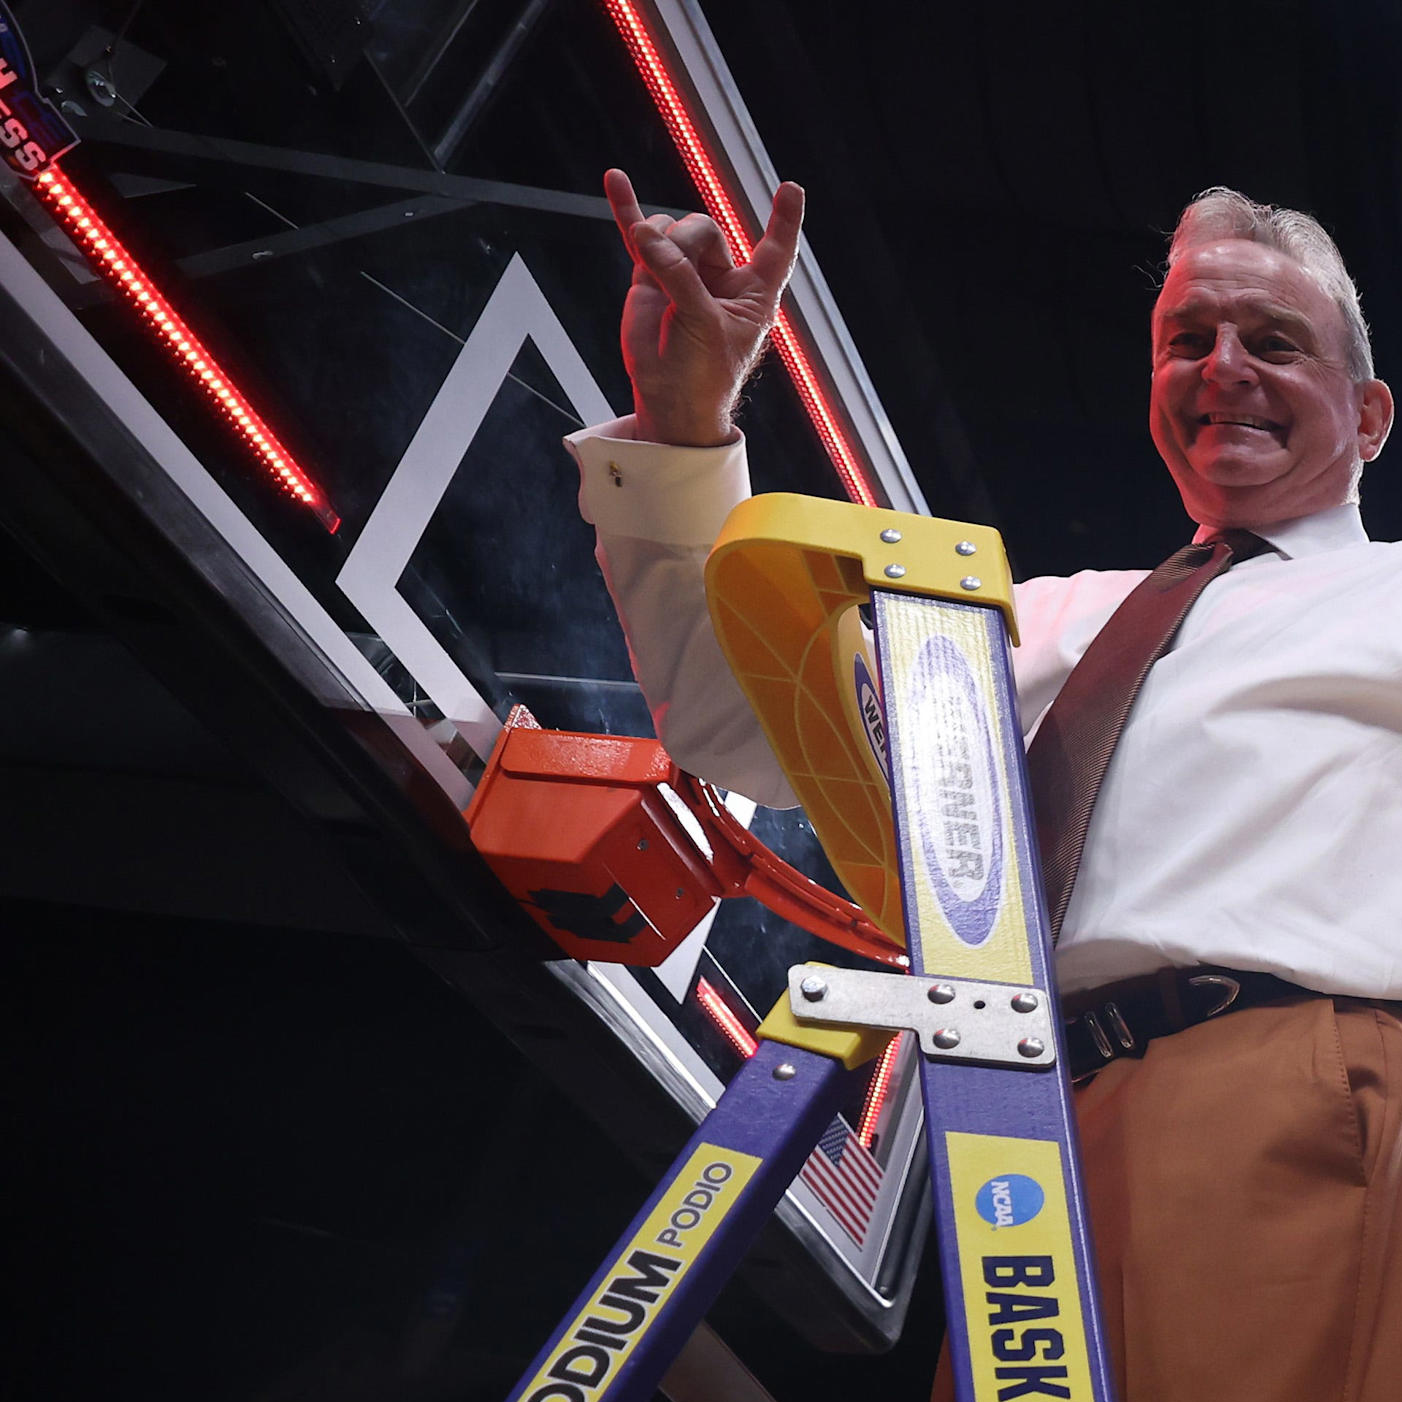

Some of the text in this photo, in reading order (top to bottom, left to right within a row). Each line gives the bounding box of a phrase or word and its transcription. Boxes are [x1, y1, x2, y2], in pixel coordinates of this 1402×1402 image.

[864, 695, 886, 753] WE
[657, 1162, 733, 1247] PODIO
[991, 1181, 1013, 1226] NCAA
